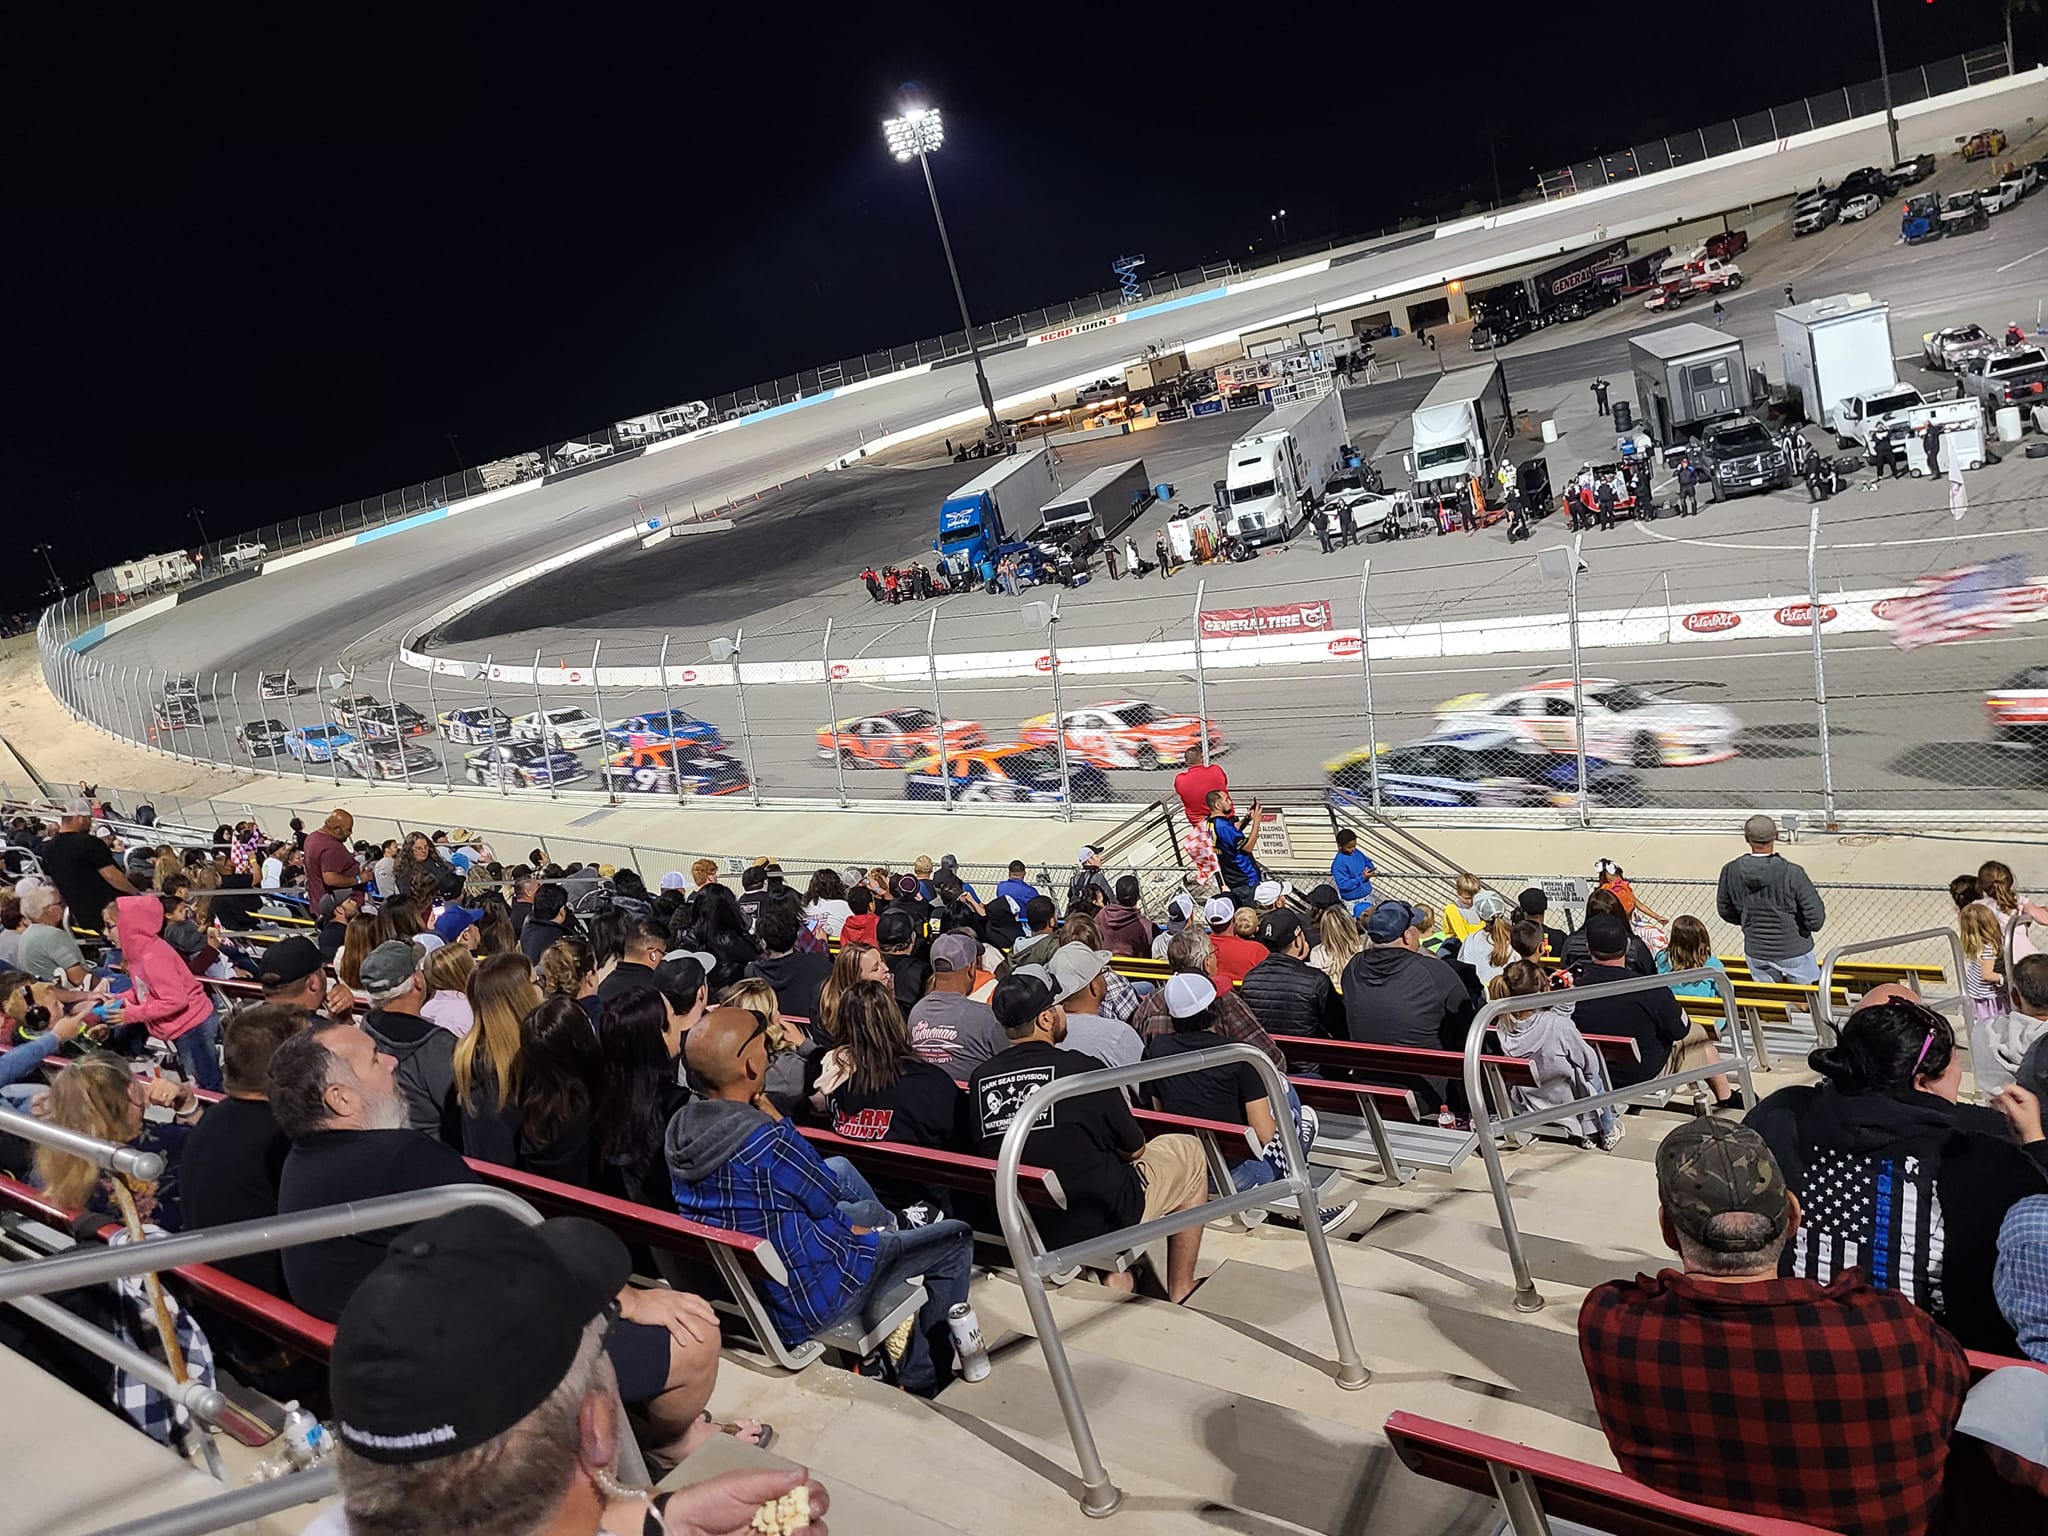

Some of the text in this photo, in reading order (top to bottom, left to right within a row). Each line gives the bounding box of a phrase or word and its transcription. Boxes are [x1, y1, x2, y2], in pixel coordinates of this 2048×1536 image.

[1552, 268, 1591, 294] GENERAL
[1040, 317, 1117, 342] KCRP TURN 3
[1203, 613, 1301, 632] GENERAL TIRE
[1688, 612, 1738, 630] Peterbilt
[981, 1073, 1049, 1093] DARK SEAS DIVISION
[835, 1123, 889, 1140] COUNTY
[984, 1117, 1014, 1130] WATERME
